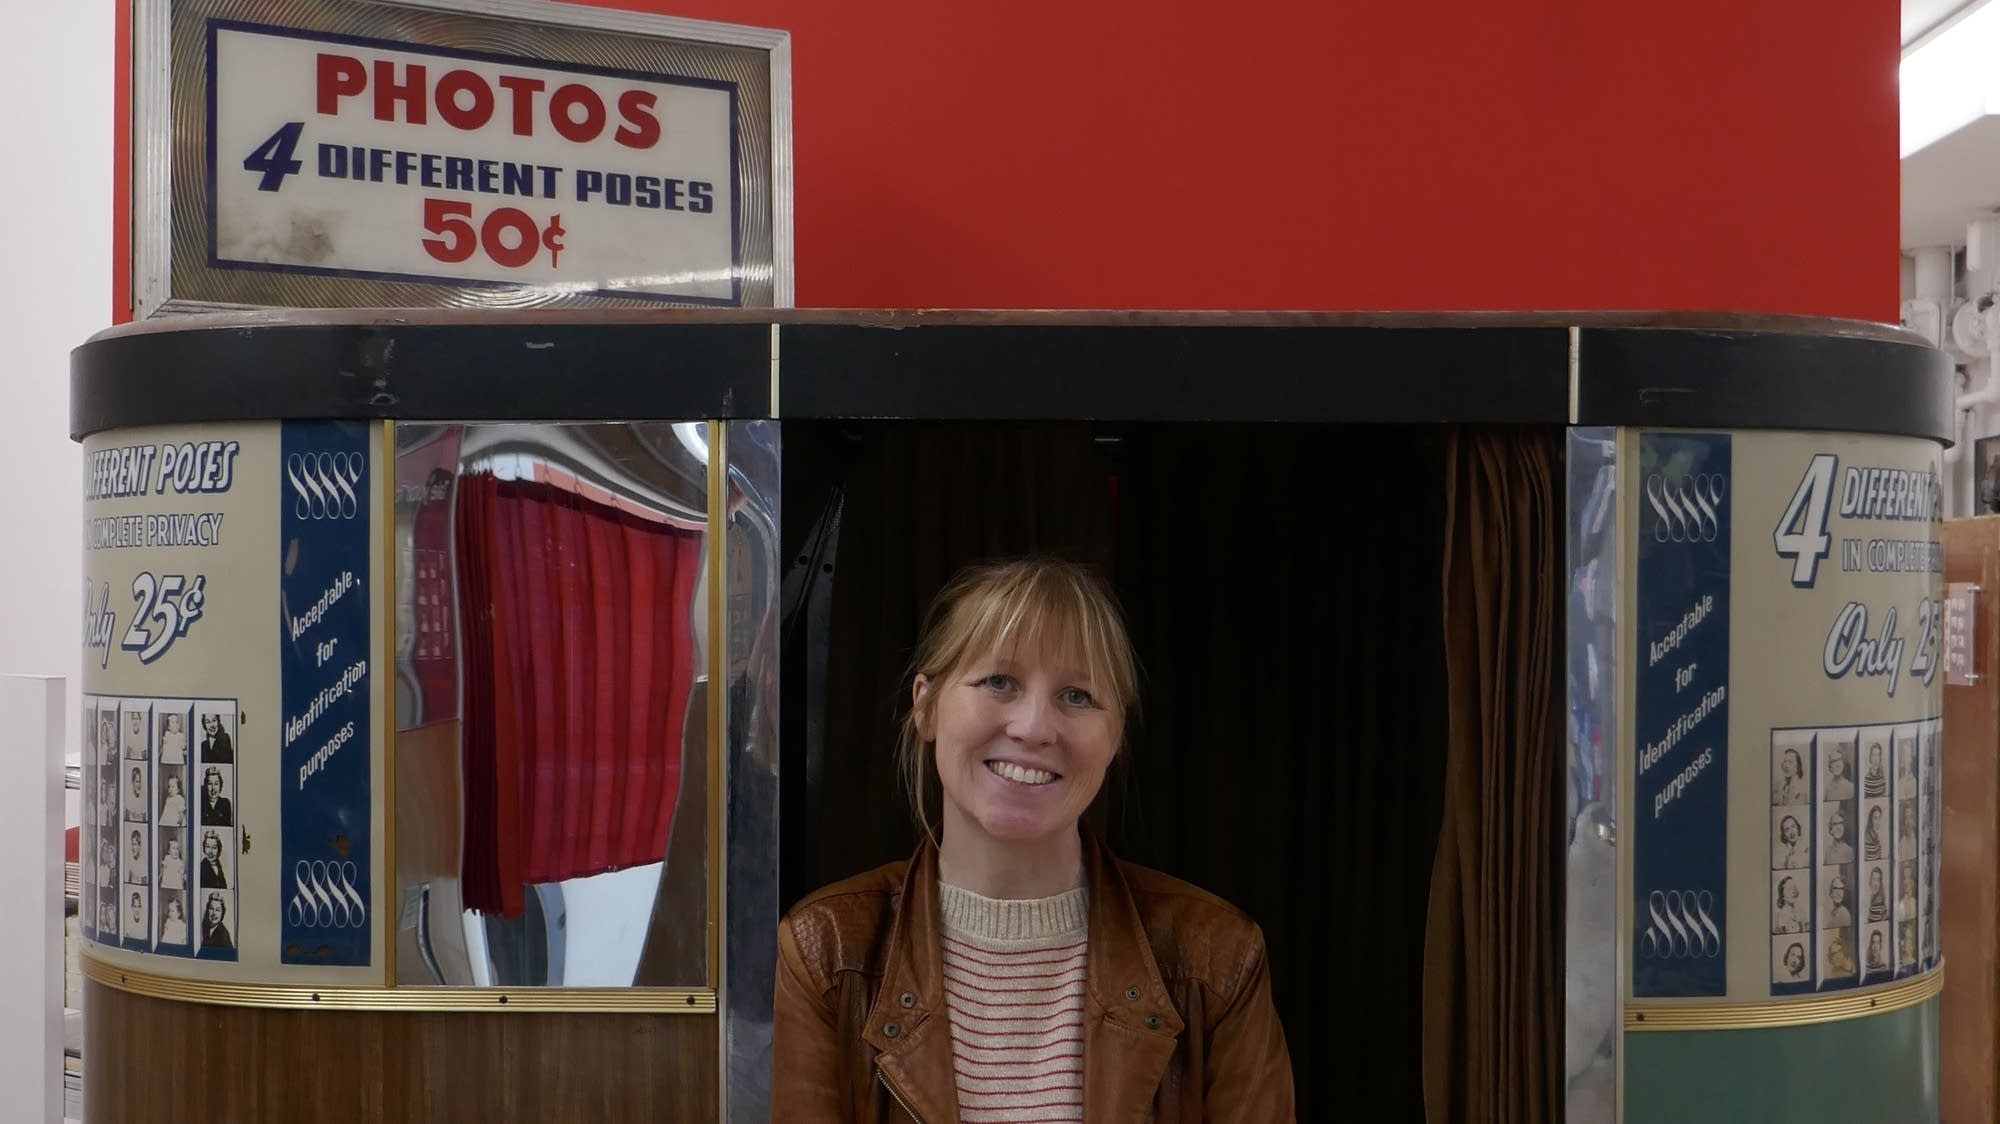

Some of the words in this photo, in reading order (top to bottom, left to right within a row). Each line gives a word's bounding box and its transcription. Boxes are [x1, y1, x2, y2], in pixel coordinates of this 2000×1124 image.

[316, 52, 661, 150] PHOTOS
[243, 122, 304, 192] 4
[317, 143, 563, 201] DIFFERENT
[576, 169, 713, 214] POSES
[422, 198, 566, 269] 50¢
[156, 441, 240, 495] POSES
[93, 515, 143, 549] COMPLETE
[147, 513, 224, 547] PRIVACY
[1773, 454, 1839, 589] 4
[1840, 466, 1931, 521] DIFFERENT
[1842, 539, 1862, 572] IN
[121, 571, 206, 665] 25¢
[292, 571, 352, 642] Acceptable
[1649, 595, 1713, 667] Acceptable
[316, 637, 338, 668] for
[1675, 663, 1697, 693] for
[1823, 601, 1905, 698] Only
[285, 660, 366, 747] Identification
[1639, 685, 1726, 776] Identification
[299, 721, 354, 790] purposes
[1654, 747, 1712, 819] purposes
